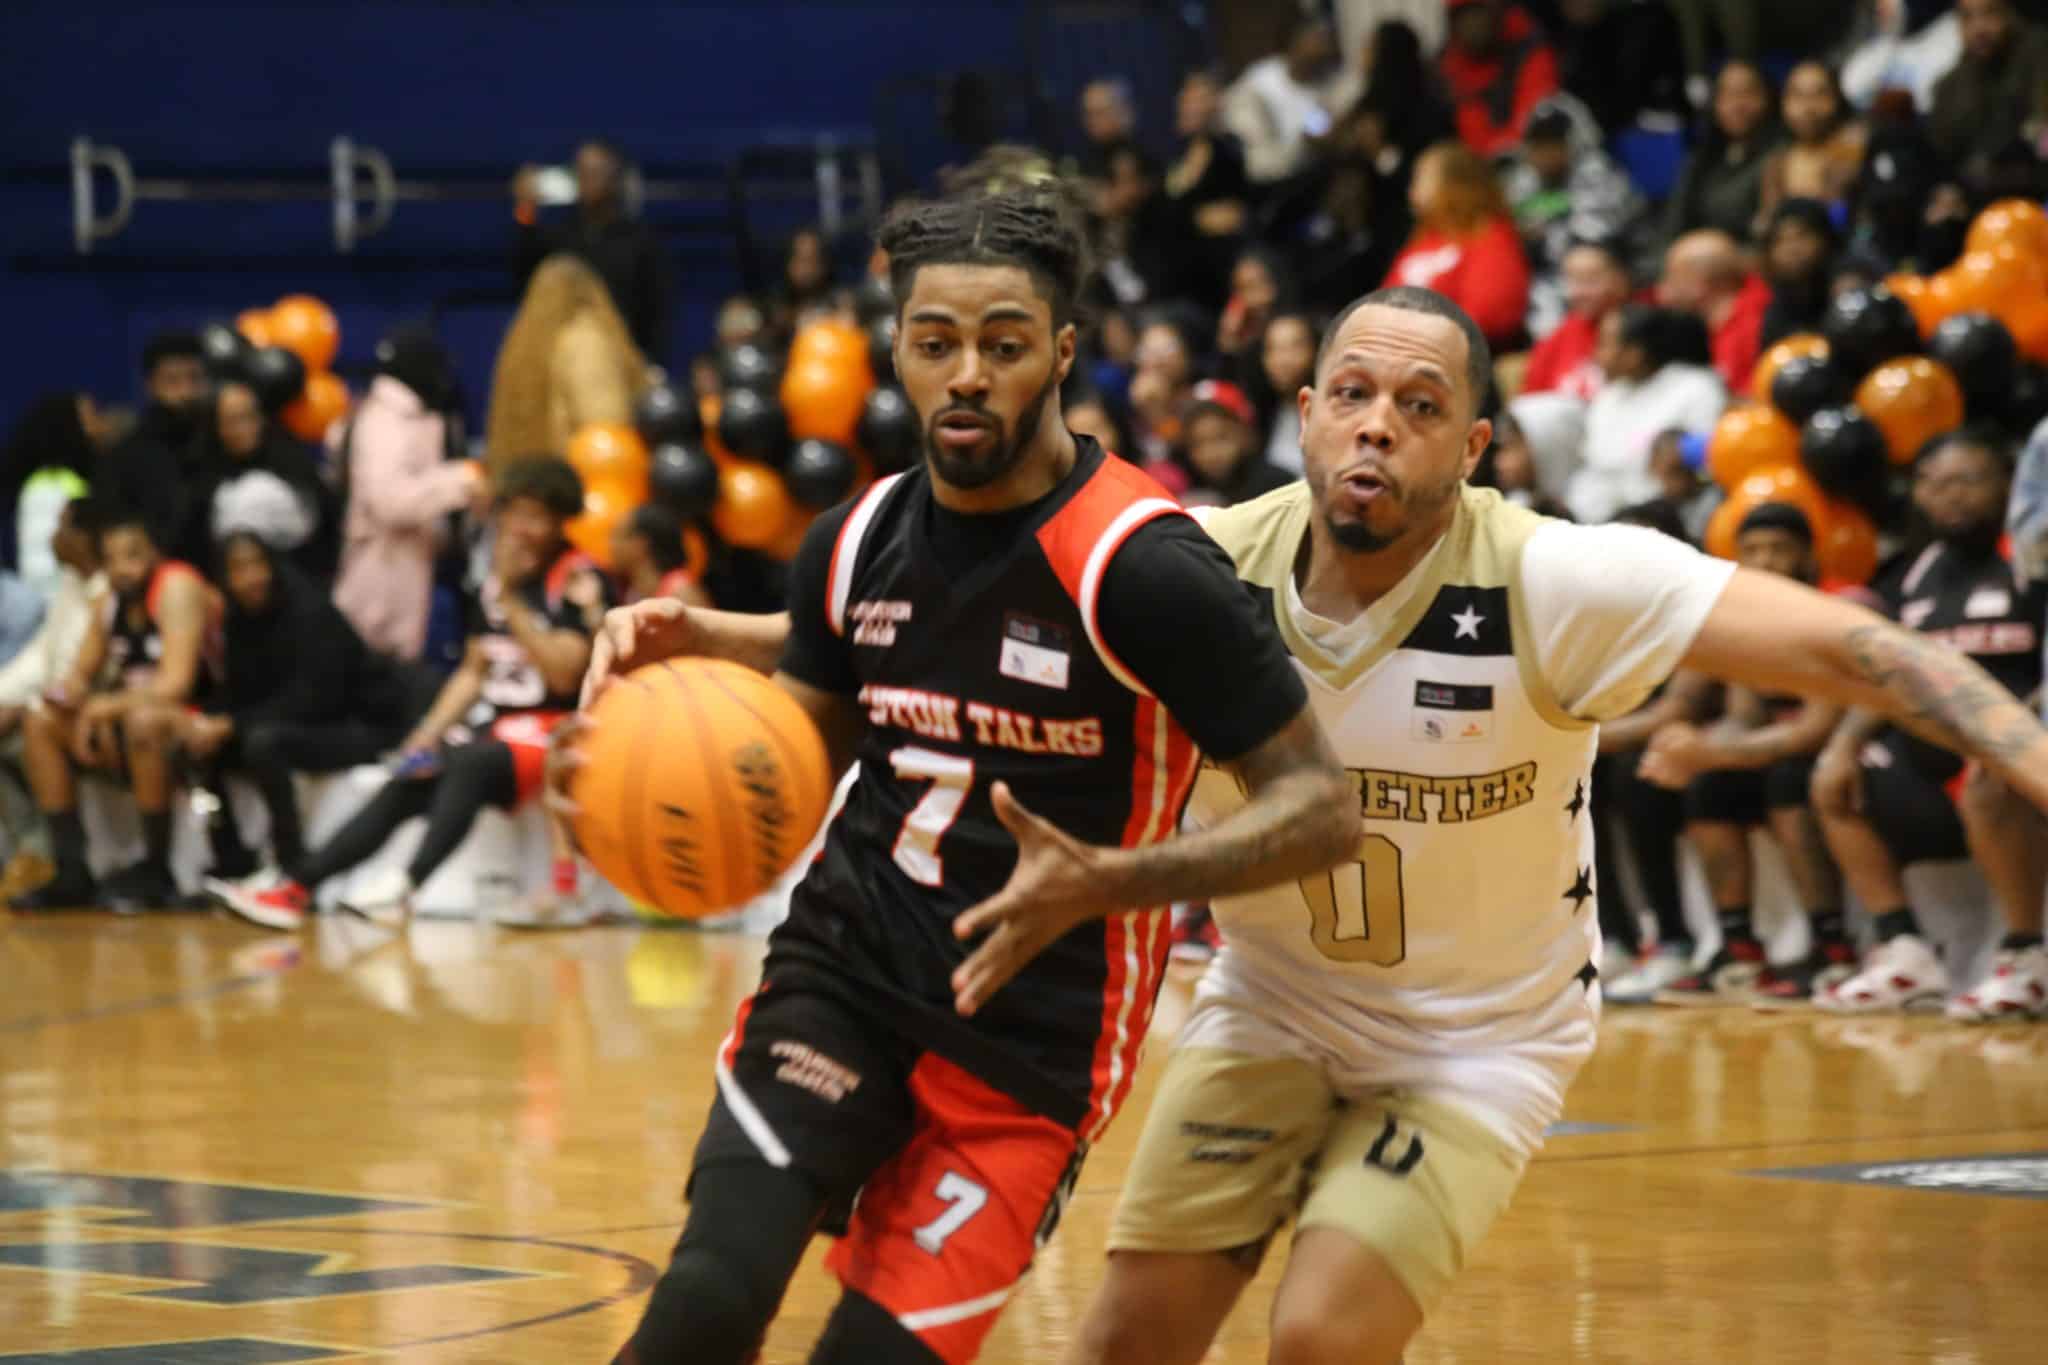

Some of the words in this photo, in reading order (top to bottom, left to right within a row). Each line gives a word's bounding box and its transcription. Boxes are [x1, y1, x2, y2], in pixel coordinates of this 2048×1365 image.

[966, 701, 1103, 757] TALKS
[889, 746, 975, 887] 7
[913, 1170, 989, 1257] 7
